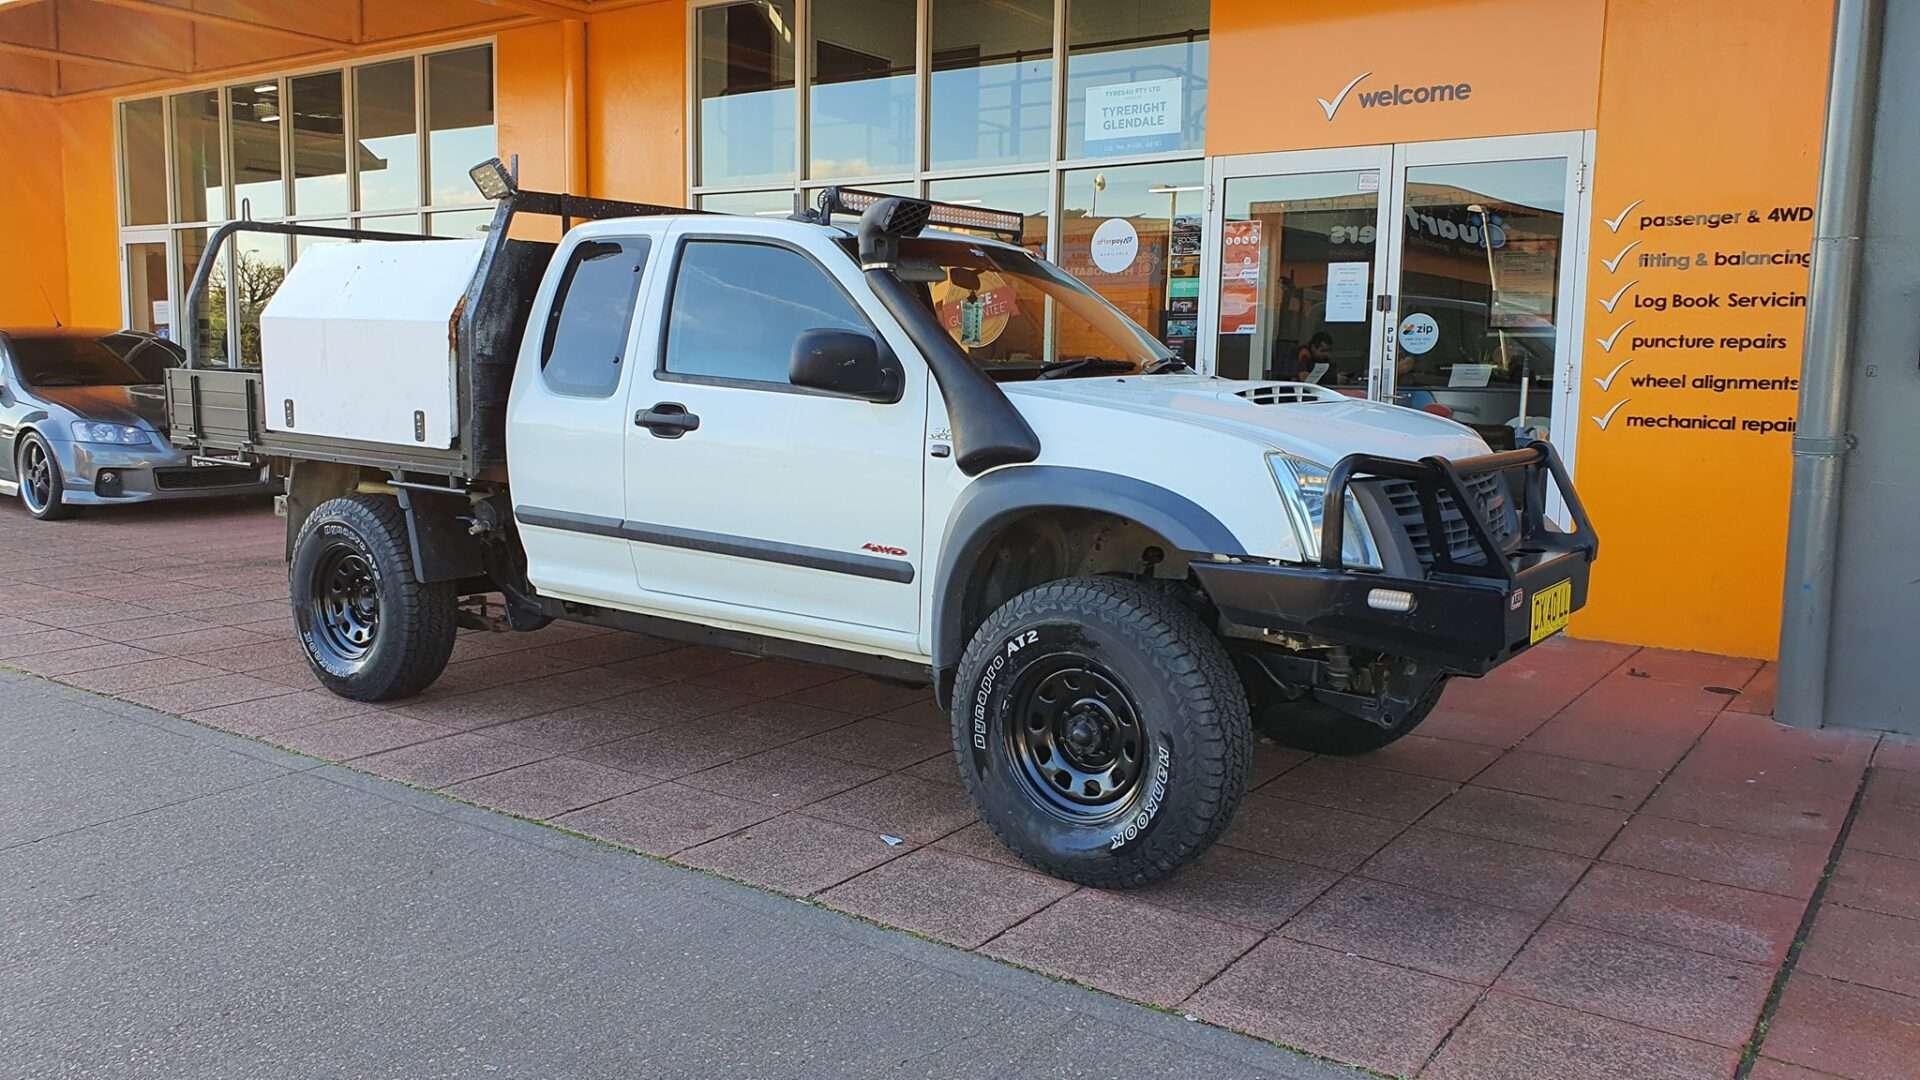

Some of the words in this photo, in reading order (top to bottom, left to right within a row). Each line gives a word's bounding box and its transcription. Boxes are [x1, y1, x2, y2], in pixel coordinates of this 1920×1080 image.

[1358, 83, 1472, 108] welcome
[1102, 101, 1167, 118] TYRERIGHT
[1103, 115, 1165, 130] GLENDALE
[1639, 211, 1741, 230] passenger
[1747, 209, 1760, 223] &
[1768, 207, 1814, 222] 4WD
[1638, 252, 1690, 270] fitting
[1695, 252, 1708, 266] &
[1714, 249, 1810, 268] balancing
[1634, 294, 1667, 311] Log
[1672, 293, 1720, 308] Book
[1728, 292, 1806, 308] Servicin
[1417, 324, 1433, 334] zip
[1386, 327, 1394, 361] PULL
[1632, 335, 1715, 351] puncture
[1720, 334, 1787, 352] repairs
[1630, 374, 1686, 389] wheel
[1692, 375, 1799, 392] alignments
[1627, 415, 1736, 431] mechanical
[1742, 415, 1796, 434] repair
[974, 655, 1005, 750] Dynapro
[1006, 629, 1039, 658] AT2
[1110, 745, 1169, 850] Hankook
